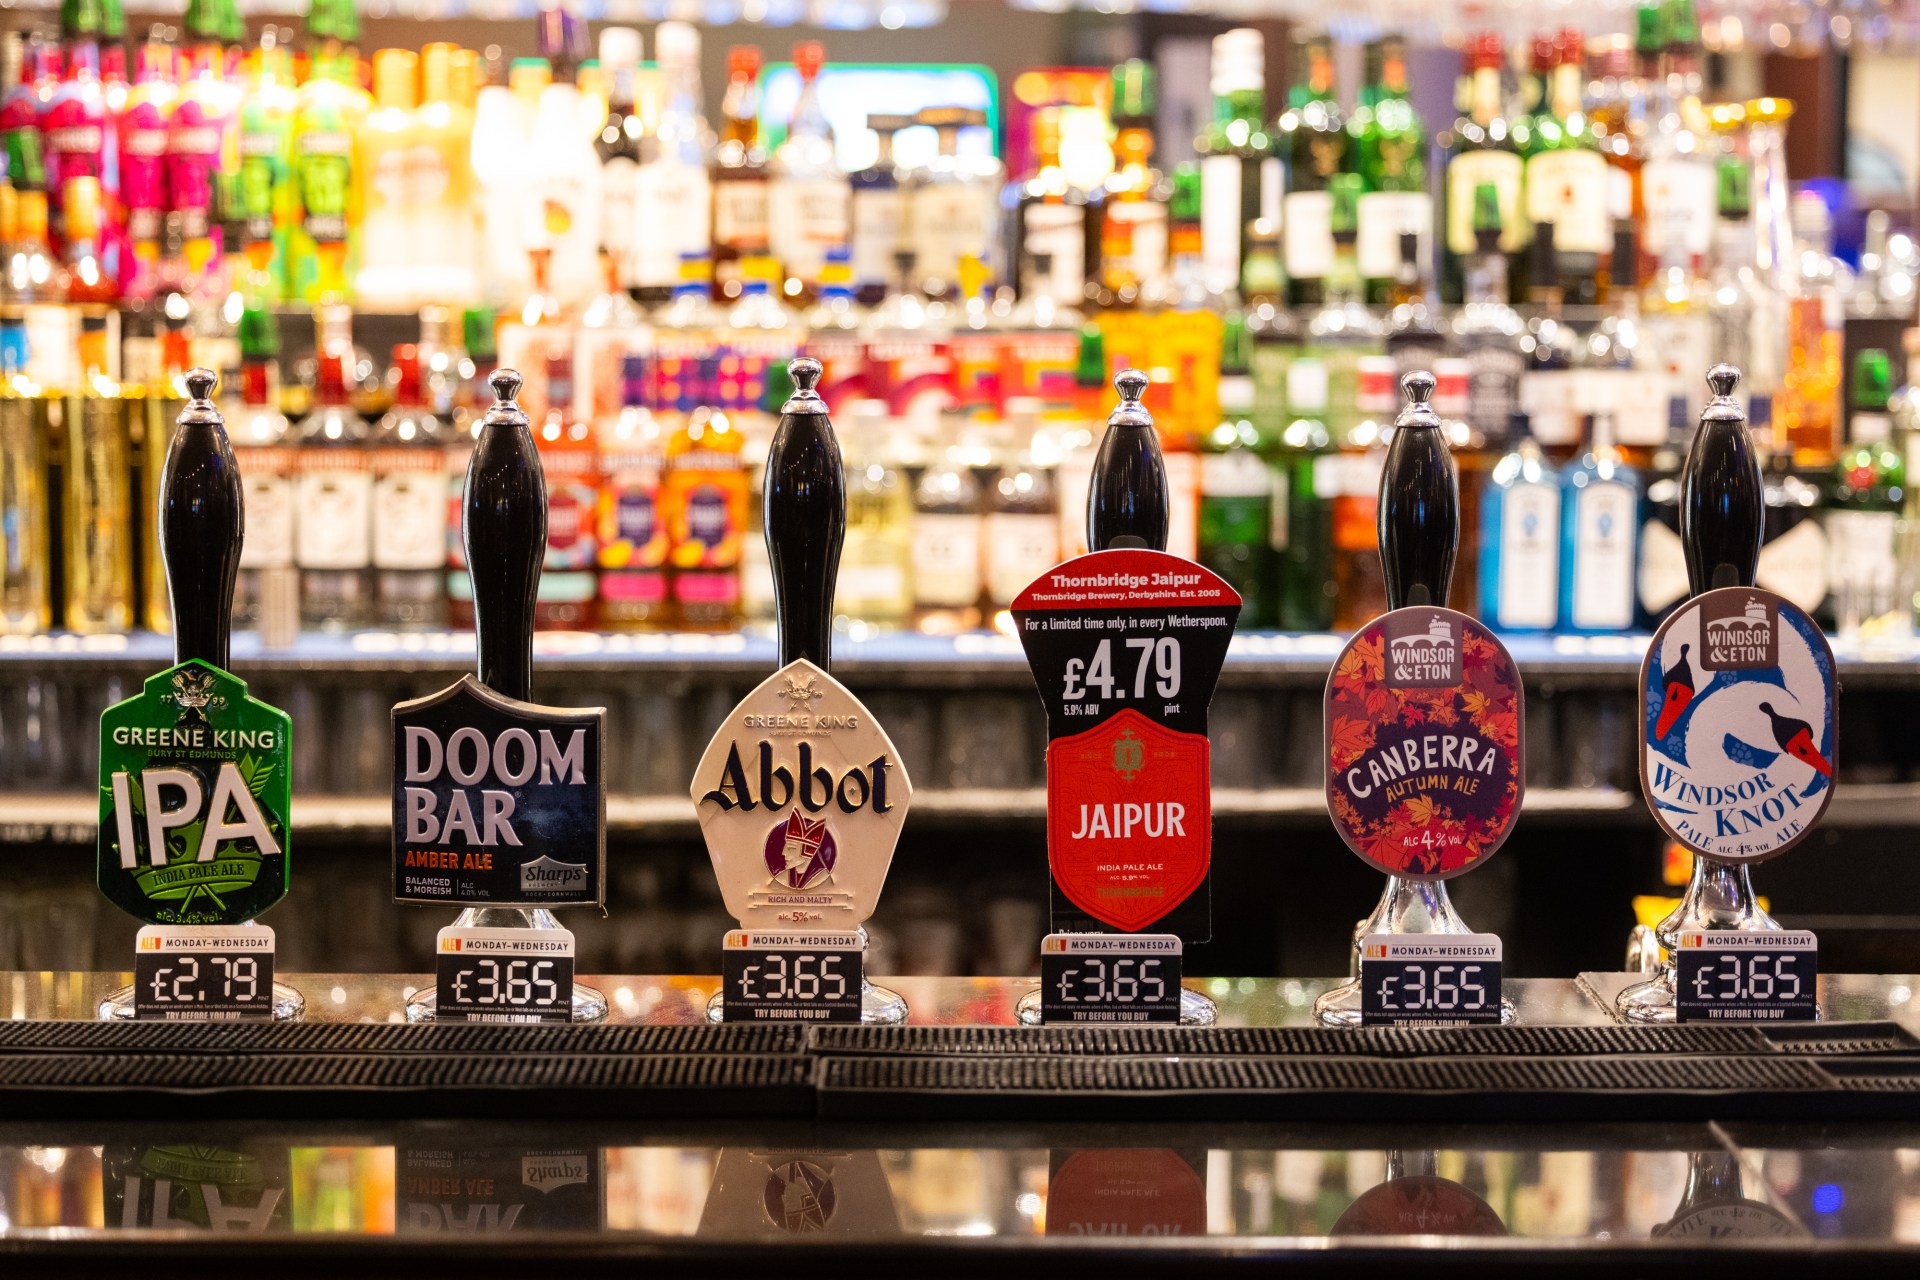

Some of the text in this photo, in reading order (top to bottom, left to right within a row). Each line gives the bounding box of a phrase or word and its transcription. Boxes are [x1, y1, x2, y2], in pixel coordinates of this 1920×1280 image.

[1051, 572, 1201, 588] Thornbridge Jaipur
[1032, 590, 1220, 601] Thornbridge Brewery, Derbyshire. Est. 2005
[1026, 614, 1228, 632] For a limited time only, in every Wetherspoon.
[1707, 629, 1770, 646] WINDSOR
[1391, 648, 1454, 664] WINDSOR
[1063, 637, 1180, 700] £4.79
[213, 696, 225, 706] 99
[1064, 704, 1099, 716] 5.9% ABV
[1164, 703, 1180, 716] pint
[744, 715, 859, 729] GREENE KING
[113, 726, 274, 748] GREENE KING
[148, 750, 236, 759] BURY ST EDMUNDS
[404, 726, 586, 786] DOOM
[1347, 735, 1496, 798] CANBERRA
[698, 739, 895, 814] Abbot
[1654, 762, 1776, 806] WINDSOR
[1386, 774, 1480, 803] AUTUMN ALE
[112, 762, 281, 869] IPA
[404, 787, 523, 846] BAR
[1713, 783, 1804, 838] KNOT
[1072, 802, 1186, 839] JAIPUR
[1404, 836, 1418, 847] ALC
[1448, 835, 1462, 846] VOL
[1676, 818, 1804, 850] PALE ALE
[1755, 843, 1772, 852] VOL
[405, 850, 493, 870] AMBER ALE
[152, 864, 244, 886] INDIA PALE ALE
[406, 876, 450, 886] BALANCED
[525, 866, 582, 885] Sharp's
[414, 886, 452, 895] MOREISH
[156, 910, 174, 922] alc.
[203, 912, 222, 923] vol.
[792, 912, 808, 922] 5%
[142, 937, 155, 950] ALE
[442, 938, 456, 952] ALE
[1682, 934, 1696, 948] ALE
[1366, 944, 1380, 958] ALE
[150, 958, 257, 1001] £2.79
[451, 960, 557, 1005] £3.65
[738, 956, 846, 999] £3.65
[1056, 960, 1164, 1002] £3.65
[1692, 956, 1800, 999] £3.65
[1376, 966, 1485, 1009] £3.65
[166, 1011, 241, 1020] TRY BEFORE YOU BUY
[467, 1014, 480, 1023] TRY
[482, 1014, 509, 1023] BEFORE
[754, 1009, 830, 1018] TRY BEFORE YOU BUY
[1072, 1012, 1149, 1020] TRY BEFORE YOU BUY
[1708, 1009, 1784, 1018] TRY BEFORE YOU BUY
